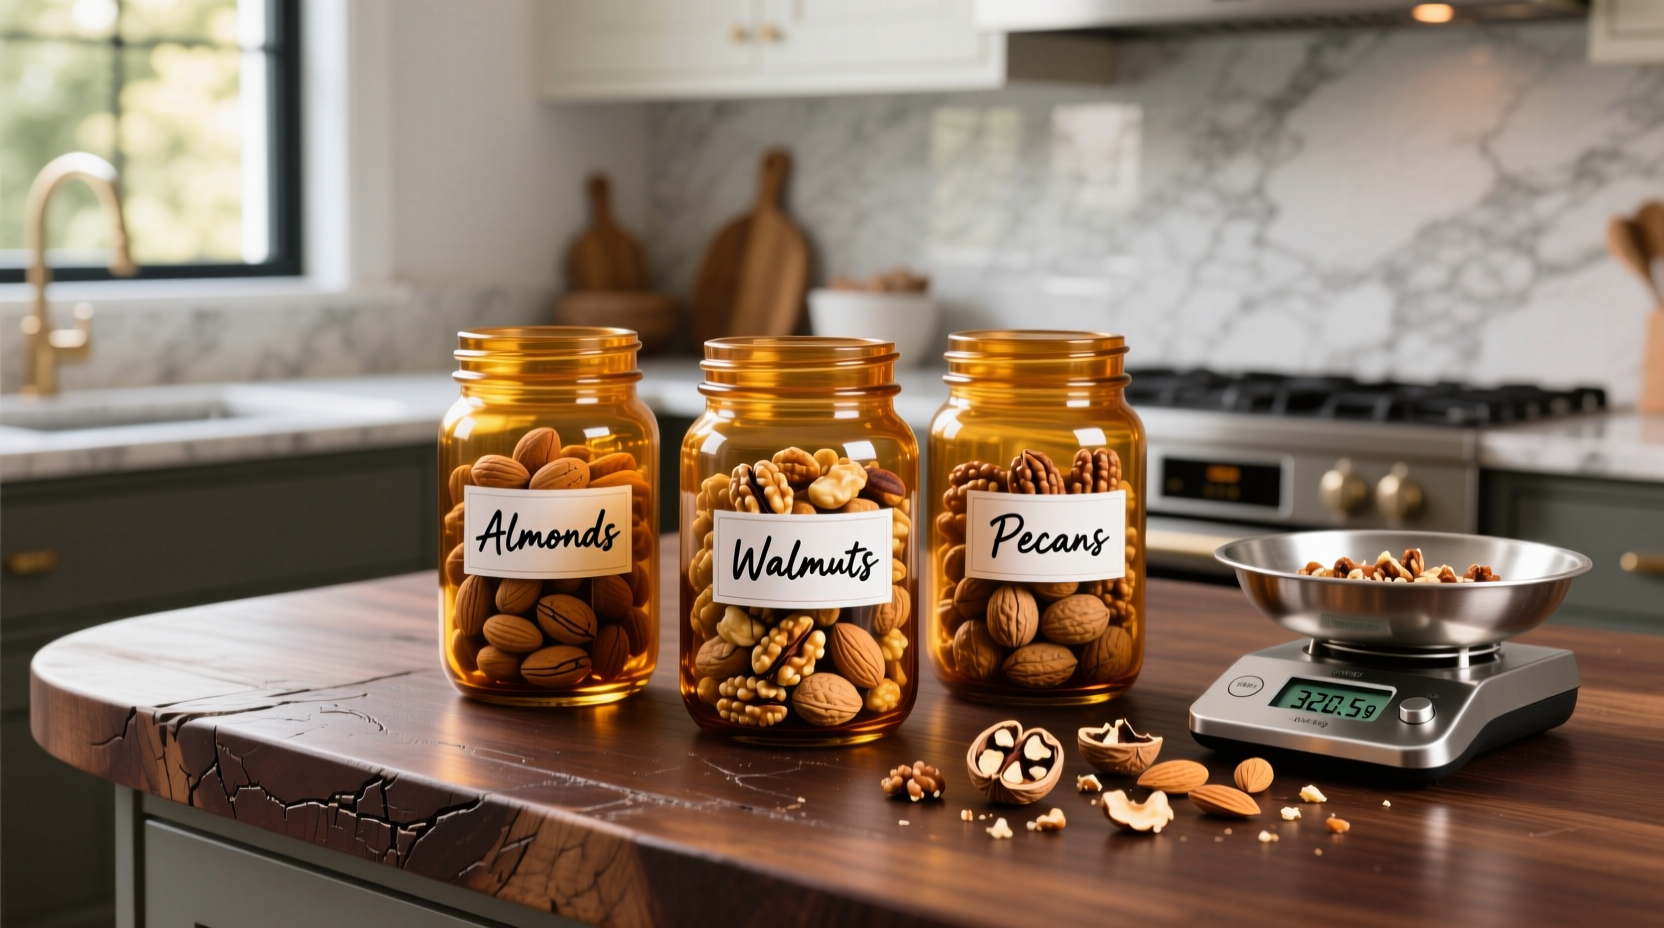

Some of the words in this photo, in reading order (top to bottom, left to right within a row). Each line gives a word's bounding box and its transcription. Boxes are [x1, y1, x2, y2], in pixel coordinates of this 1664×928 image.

[476, 509, 621, 556] Almonds
[990, 513, 1110, 559] Pecans
[732, 535, 880, 582] Walmuts
